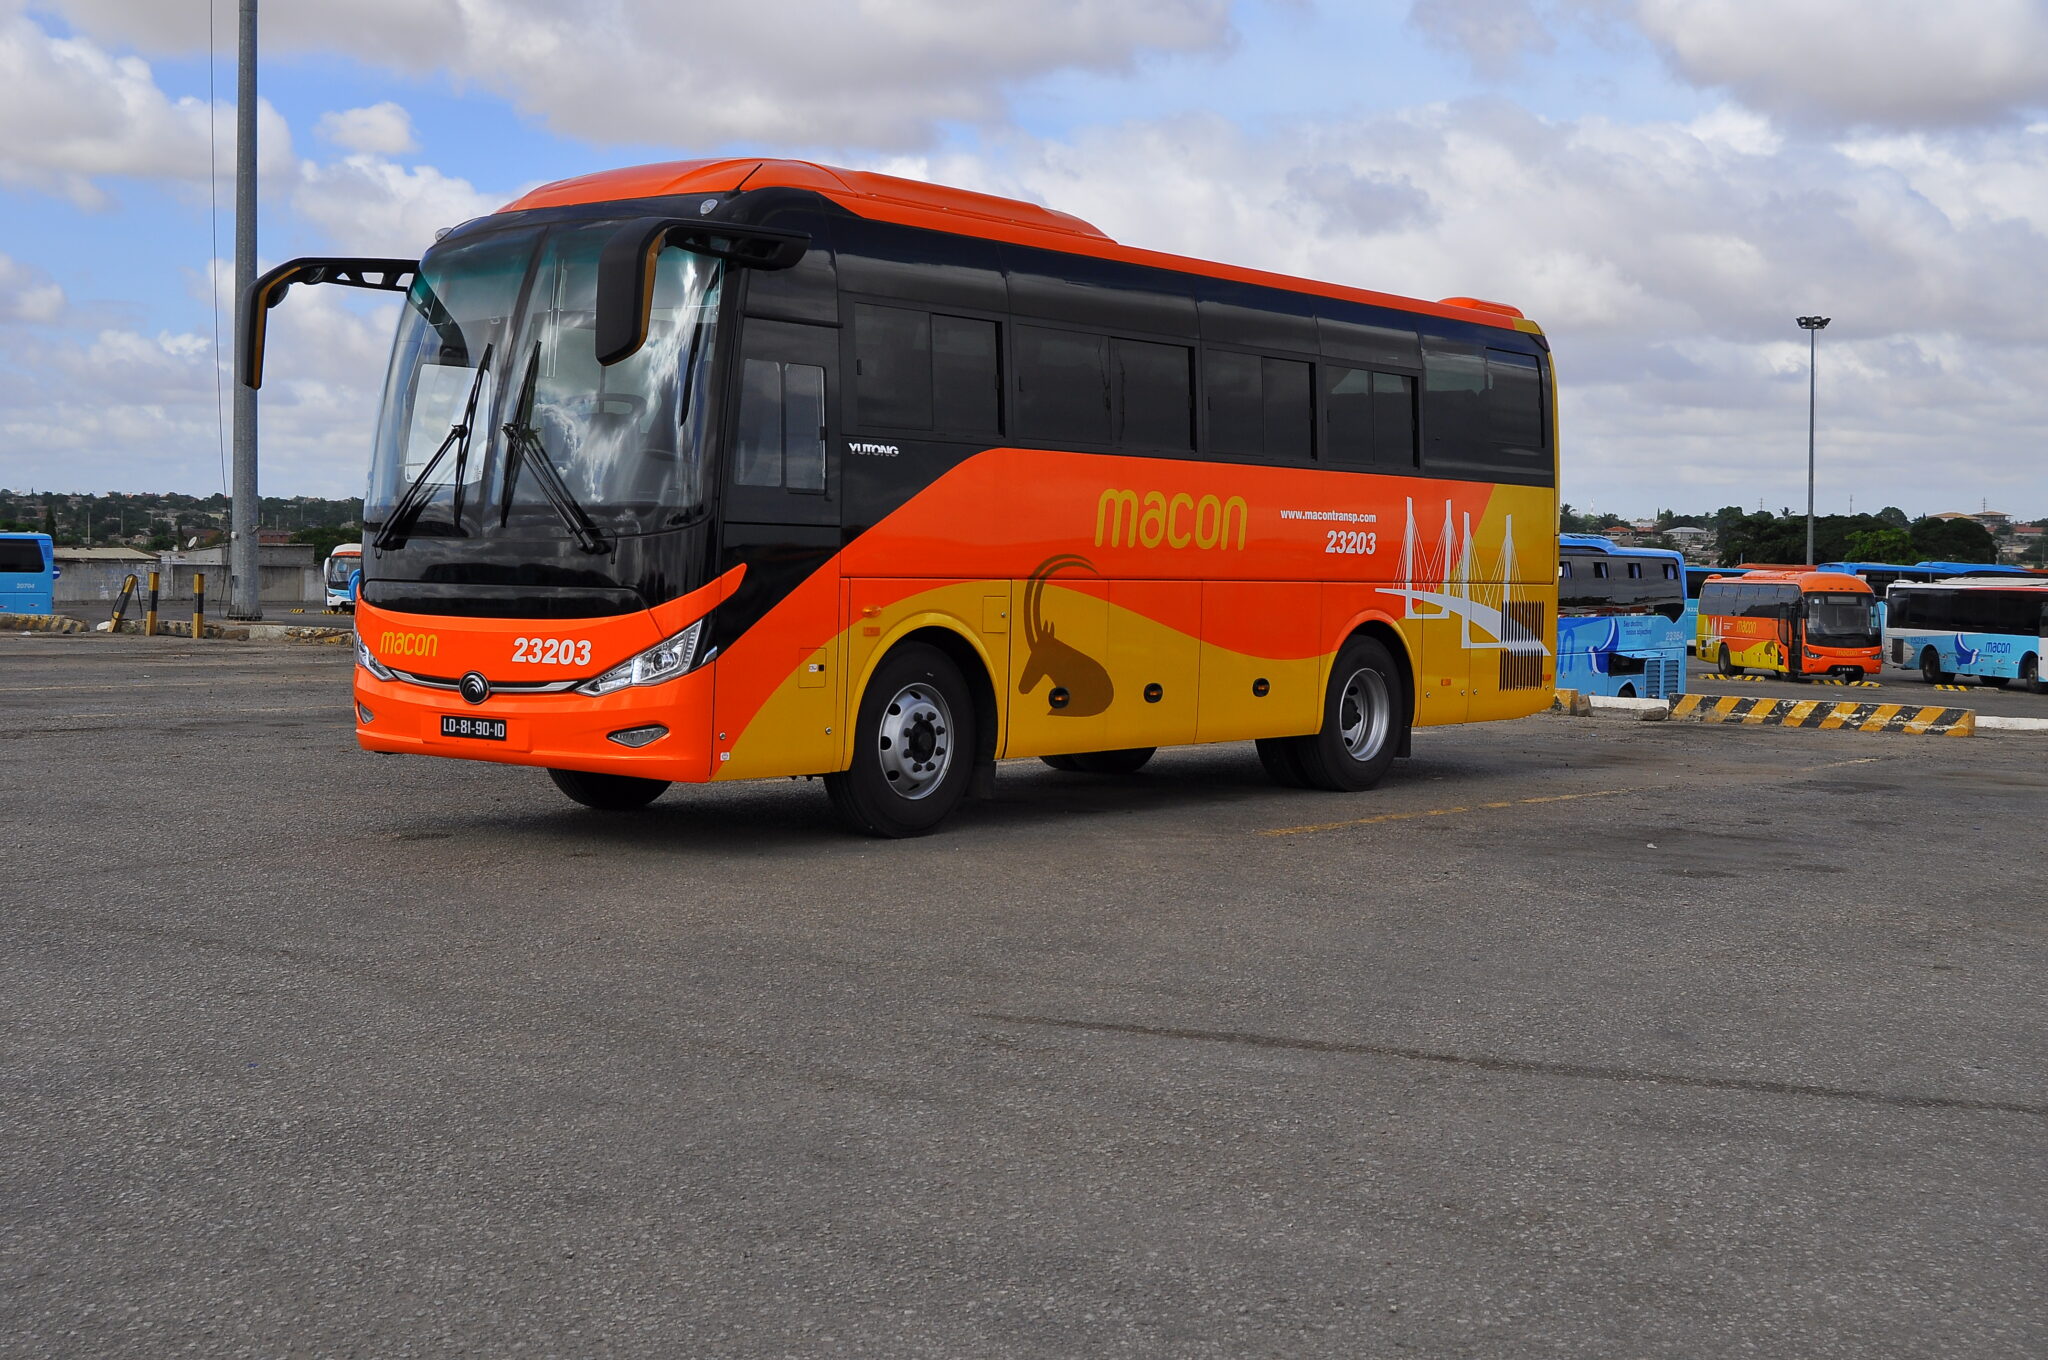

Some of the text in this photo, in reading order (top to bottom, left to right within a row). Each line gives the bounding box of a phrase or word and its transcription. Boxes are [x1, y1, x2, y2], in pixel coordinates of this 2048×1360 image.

[848, 442, 899, 457] YUTONG
[1095, 488, 1247, 551] macon
[1280, 509, 1377, 524] www.macontransp.com
[1325, 530, 1377, 555] 23203
[379, 631, 438, 657] macon
[512, 637, 591, 666] 23203
[1985, 641, 2011, 654] macon
